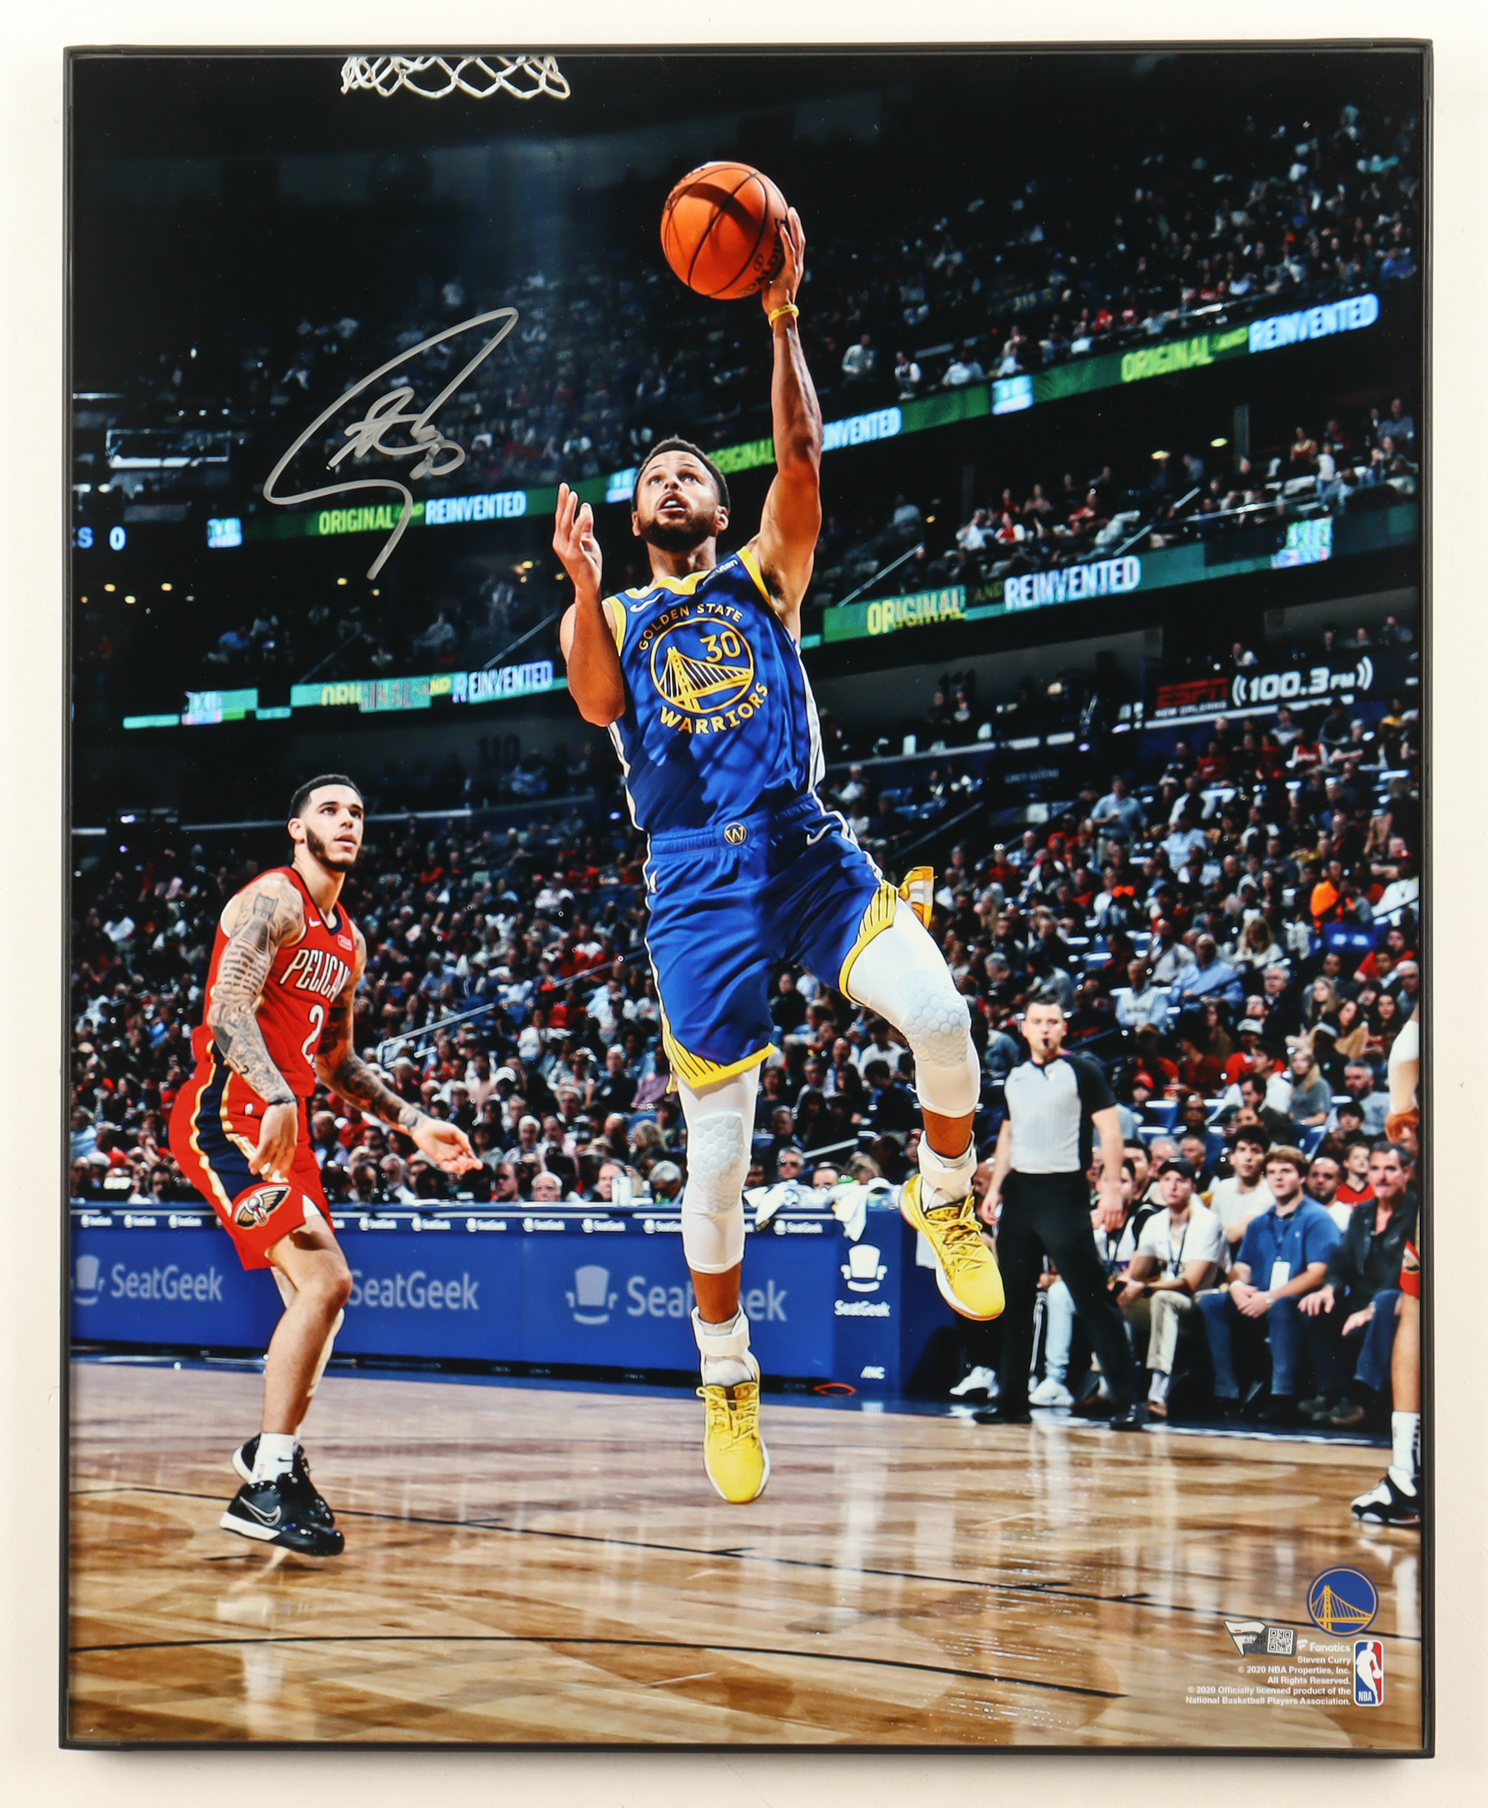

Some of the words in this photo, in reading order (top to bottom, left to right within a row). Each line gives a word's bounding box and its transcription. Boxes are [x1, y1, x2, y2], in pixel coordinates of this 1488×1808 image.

[1121, 334, 1214, 383] ORIGINAL
[1249, 293, 1379, 353] REINVENTED
[318, 504, 395, 535] ORIGINAL
[425, 490, 527, 525] REINVENTED
[109, 526, 126, 551] 0
[1004, 555, 1141, 612] REINVENTED
[638, 605, 691, 651] GOLDEN
[696, 602, 744, 623] STATE
[700, 631, 742, 663] 30
[452, 660, 554, 704] REINVENTED
[1157, 677, 1229, 708] ESPN
[659, 681, 770, 735] WARRIORS
[301, 1004, 324, 1068] 2
[111, 1264, 223, 1302] SeatGeek
[834, 1299, 891, 1318] SeatGeek
[1297, 1656, 1326, 1664] Steven
[1328, 1656, 1351, 1665] Curry
[1310, 1643, 1351, 1653] Fanatics
[1267, 1676, 1279, 1684] All
[1281, 1676, 1308, 1686] Rights
[1310, 1676, 1351, 1684] Reserved.
[1289, 1666, 1334, 1675] Properties,
[1185, 1696, 1220, 1704] National
[1222, 1696, 1266, 1704] Basketball
[1267, 1696, 1298, 1706] Players
[1299, 1696, 1351, 1705] Association.
[1196, 1686, 1216, 1694] 2020
[1217, 1686, 1254, 1695] Officially
[1256, 1686, 1291, 1694] licensed
[1293, 1687, 1327, 1696] product
[1328, 1686, 1337, 1694] of
[1338, 1686, 1351, 1694] the
[1358, 1691, 1373, 1702] NBA
